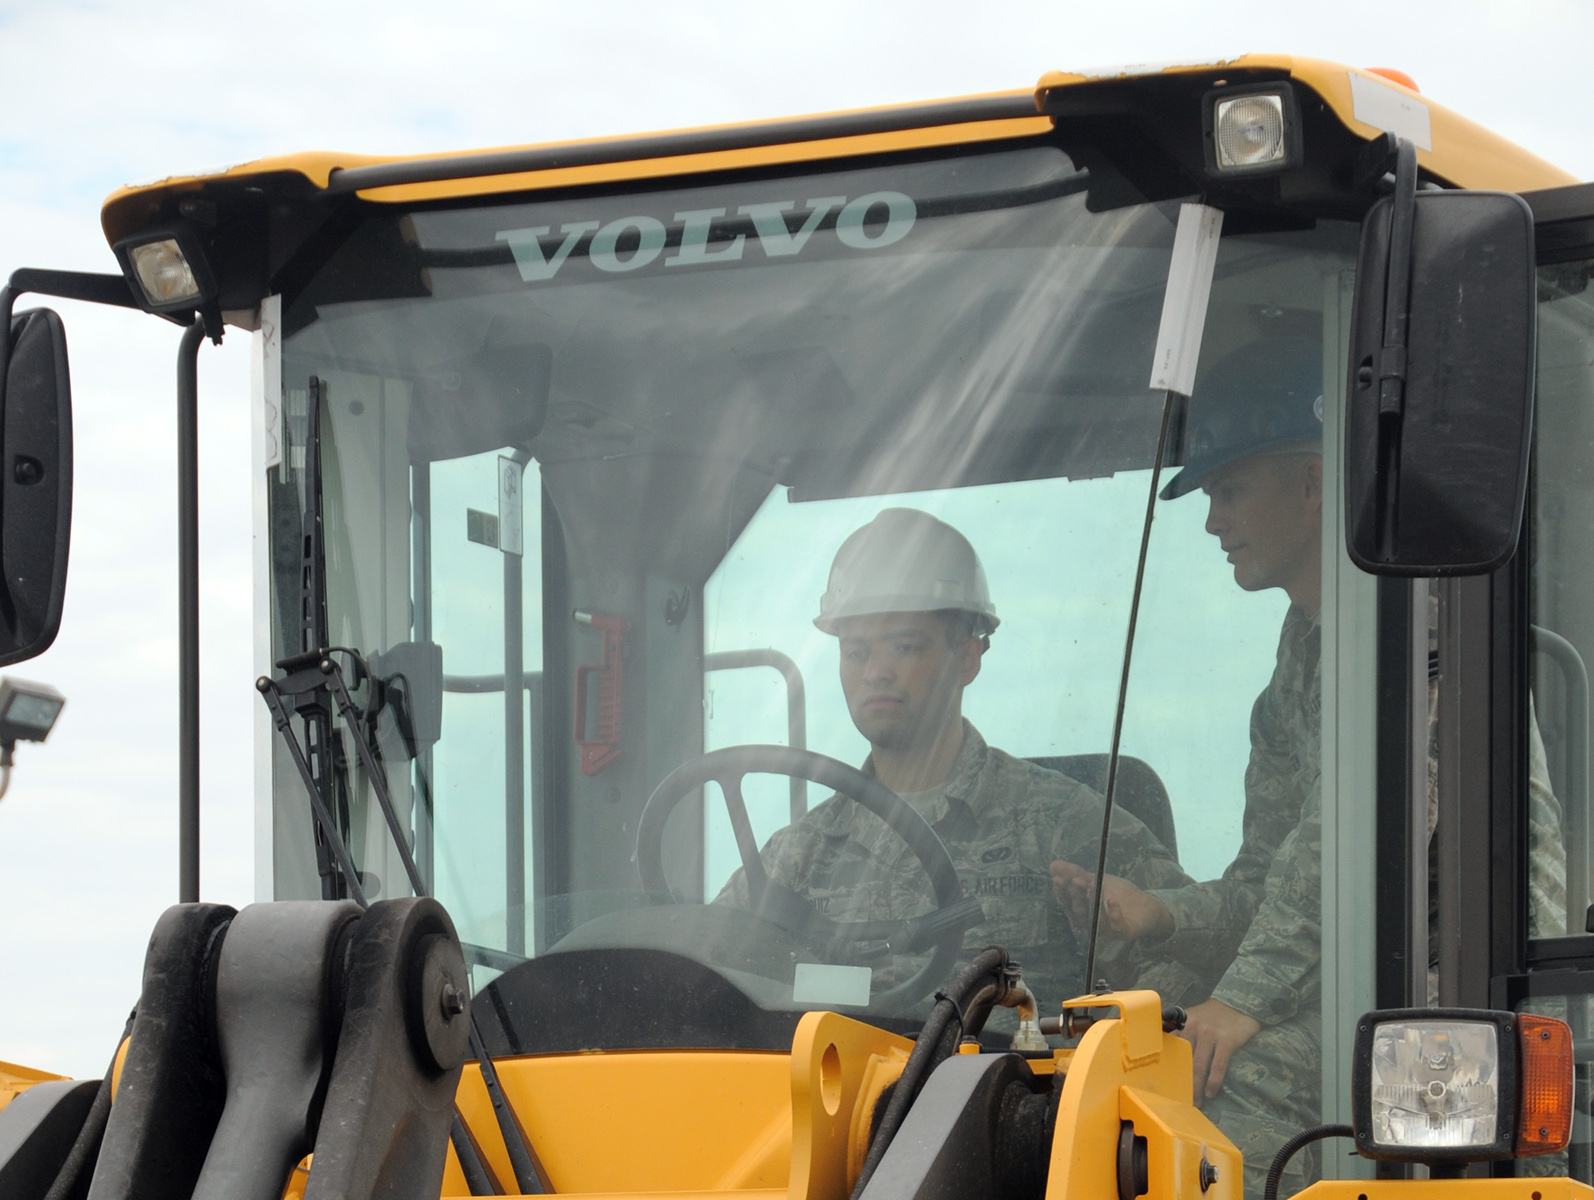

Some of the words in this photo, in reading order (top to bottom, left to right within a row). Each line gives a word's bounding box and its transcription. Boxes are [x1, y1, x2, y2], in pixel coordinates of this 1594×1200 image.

[494, 191, 917, 282] VOLVO
[975, 877, 998, 895] AIR
[1000, 875, 1044, 893] FORCE
